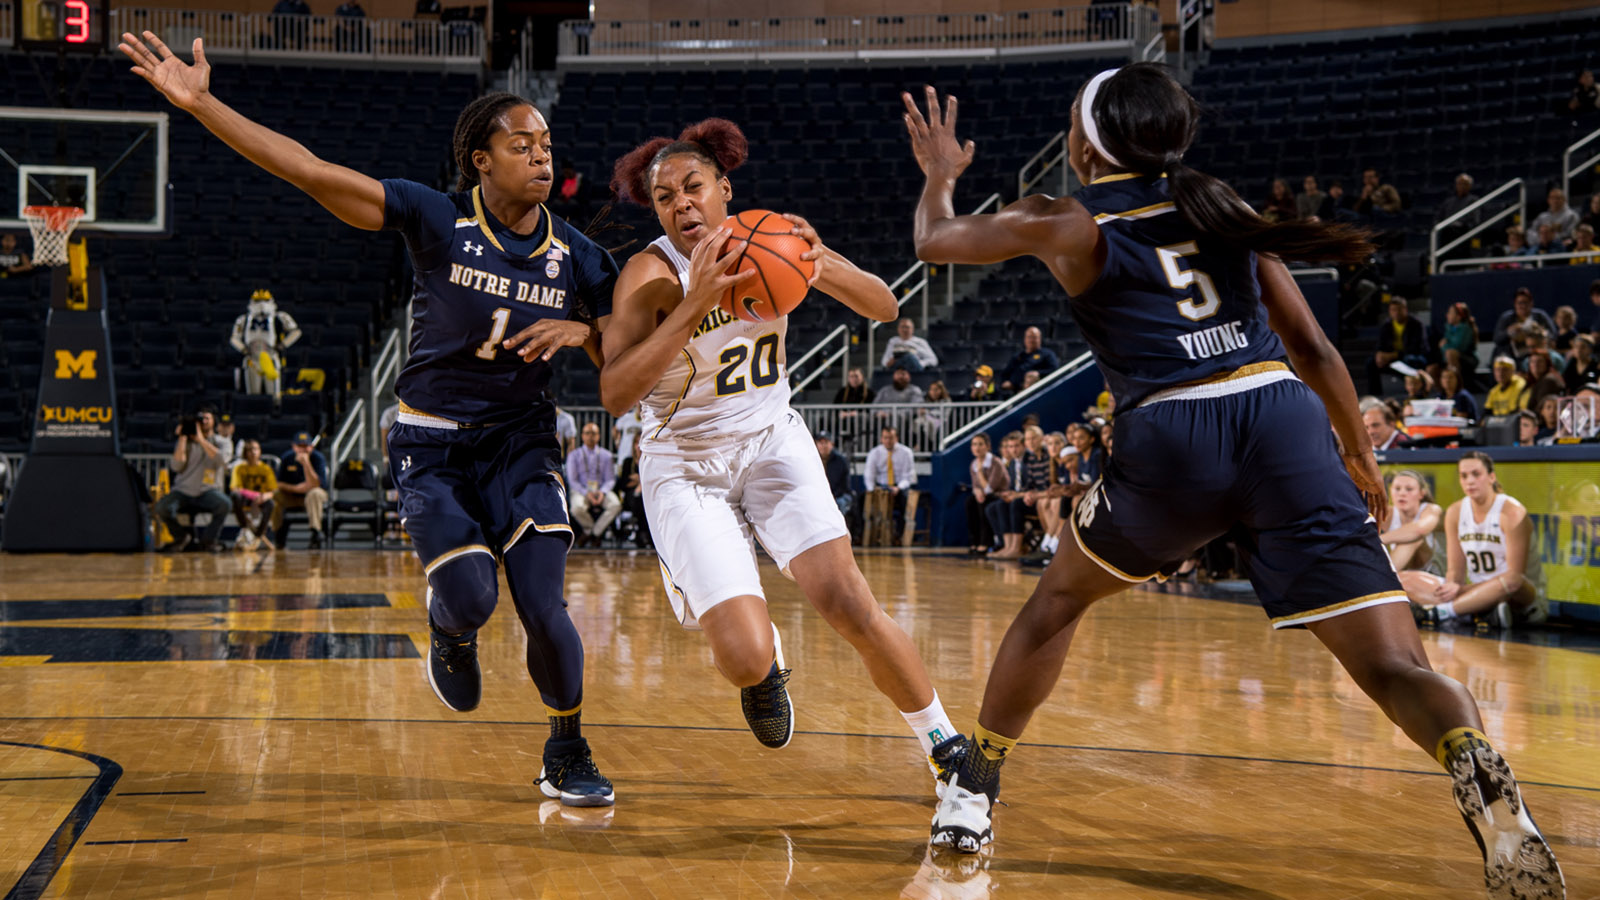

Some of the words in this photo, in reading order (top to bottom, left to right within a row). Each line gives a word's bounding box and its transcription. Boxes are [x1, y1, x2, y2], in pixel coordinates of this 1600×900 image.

[65, 0, 89, 42] 3
[449, 263, 511, 298] NOTRE
[515, 281, 566, 309] DAME
[1155, 240, 1222, 321] 5
[475, 307, 511, 360] 1
[693, 307, 739, 339] MIC
[1176, 320, 1249, 359] YOUNG
[55, 350, 97, 379] M
[715, 331, 780, 397] 20
[1466, 550, 1496, 574] 30
